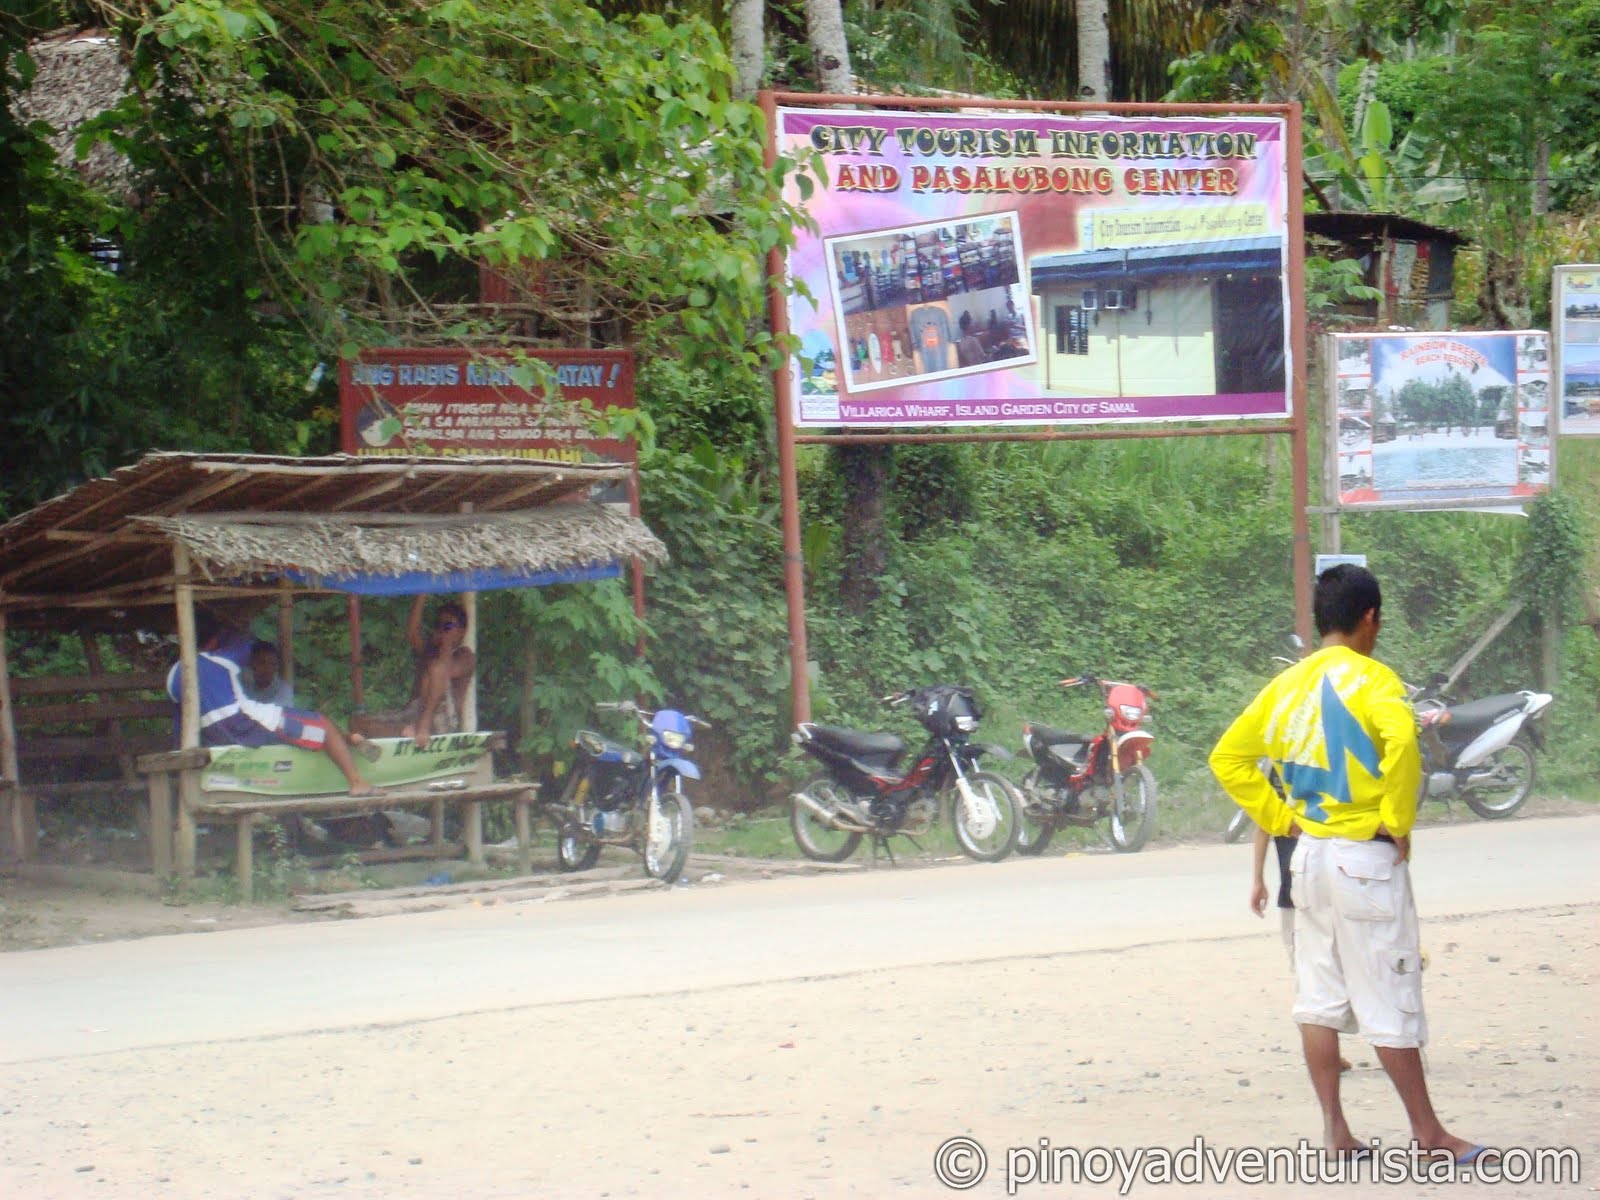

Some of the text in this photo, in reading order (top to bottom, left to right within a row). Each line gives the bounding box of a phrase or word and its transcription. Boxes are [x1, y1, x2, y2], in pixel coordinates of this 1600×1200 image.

[811, 125, 1258, 160] CITY TOURISM INFORMATION
[835, 163, 1238, 196] AND PASALUBONG CENTER
[398, 363, 460, 386] RABIS
[840, 405, 902, 418] VILLARICA
[956, 402, 1000, 417] ISLAND
[1000, 402, 1052, 416] GARDEN
[1053, 402, 1081, 415] CITY
[1081, 403, 1098, 414] OF
[1099, 401, 1138, 414] SAMAL
